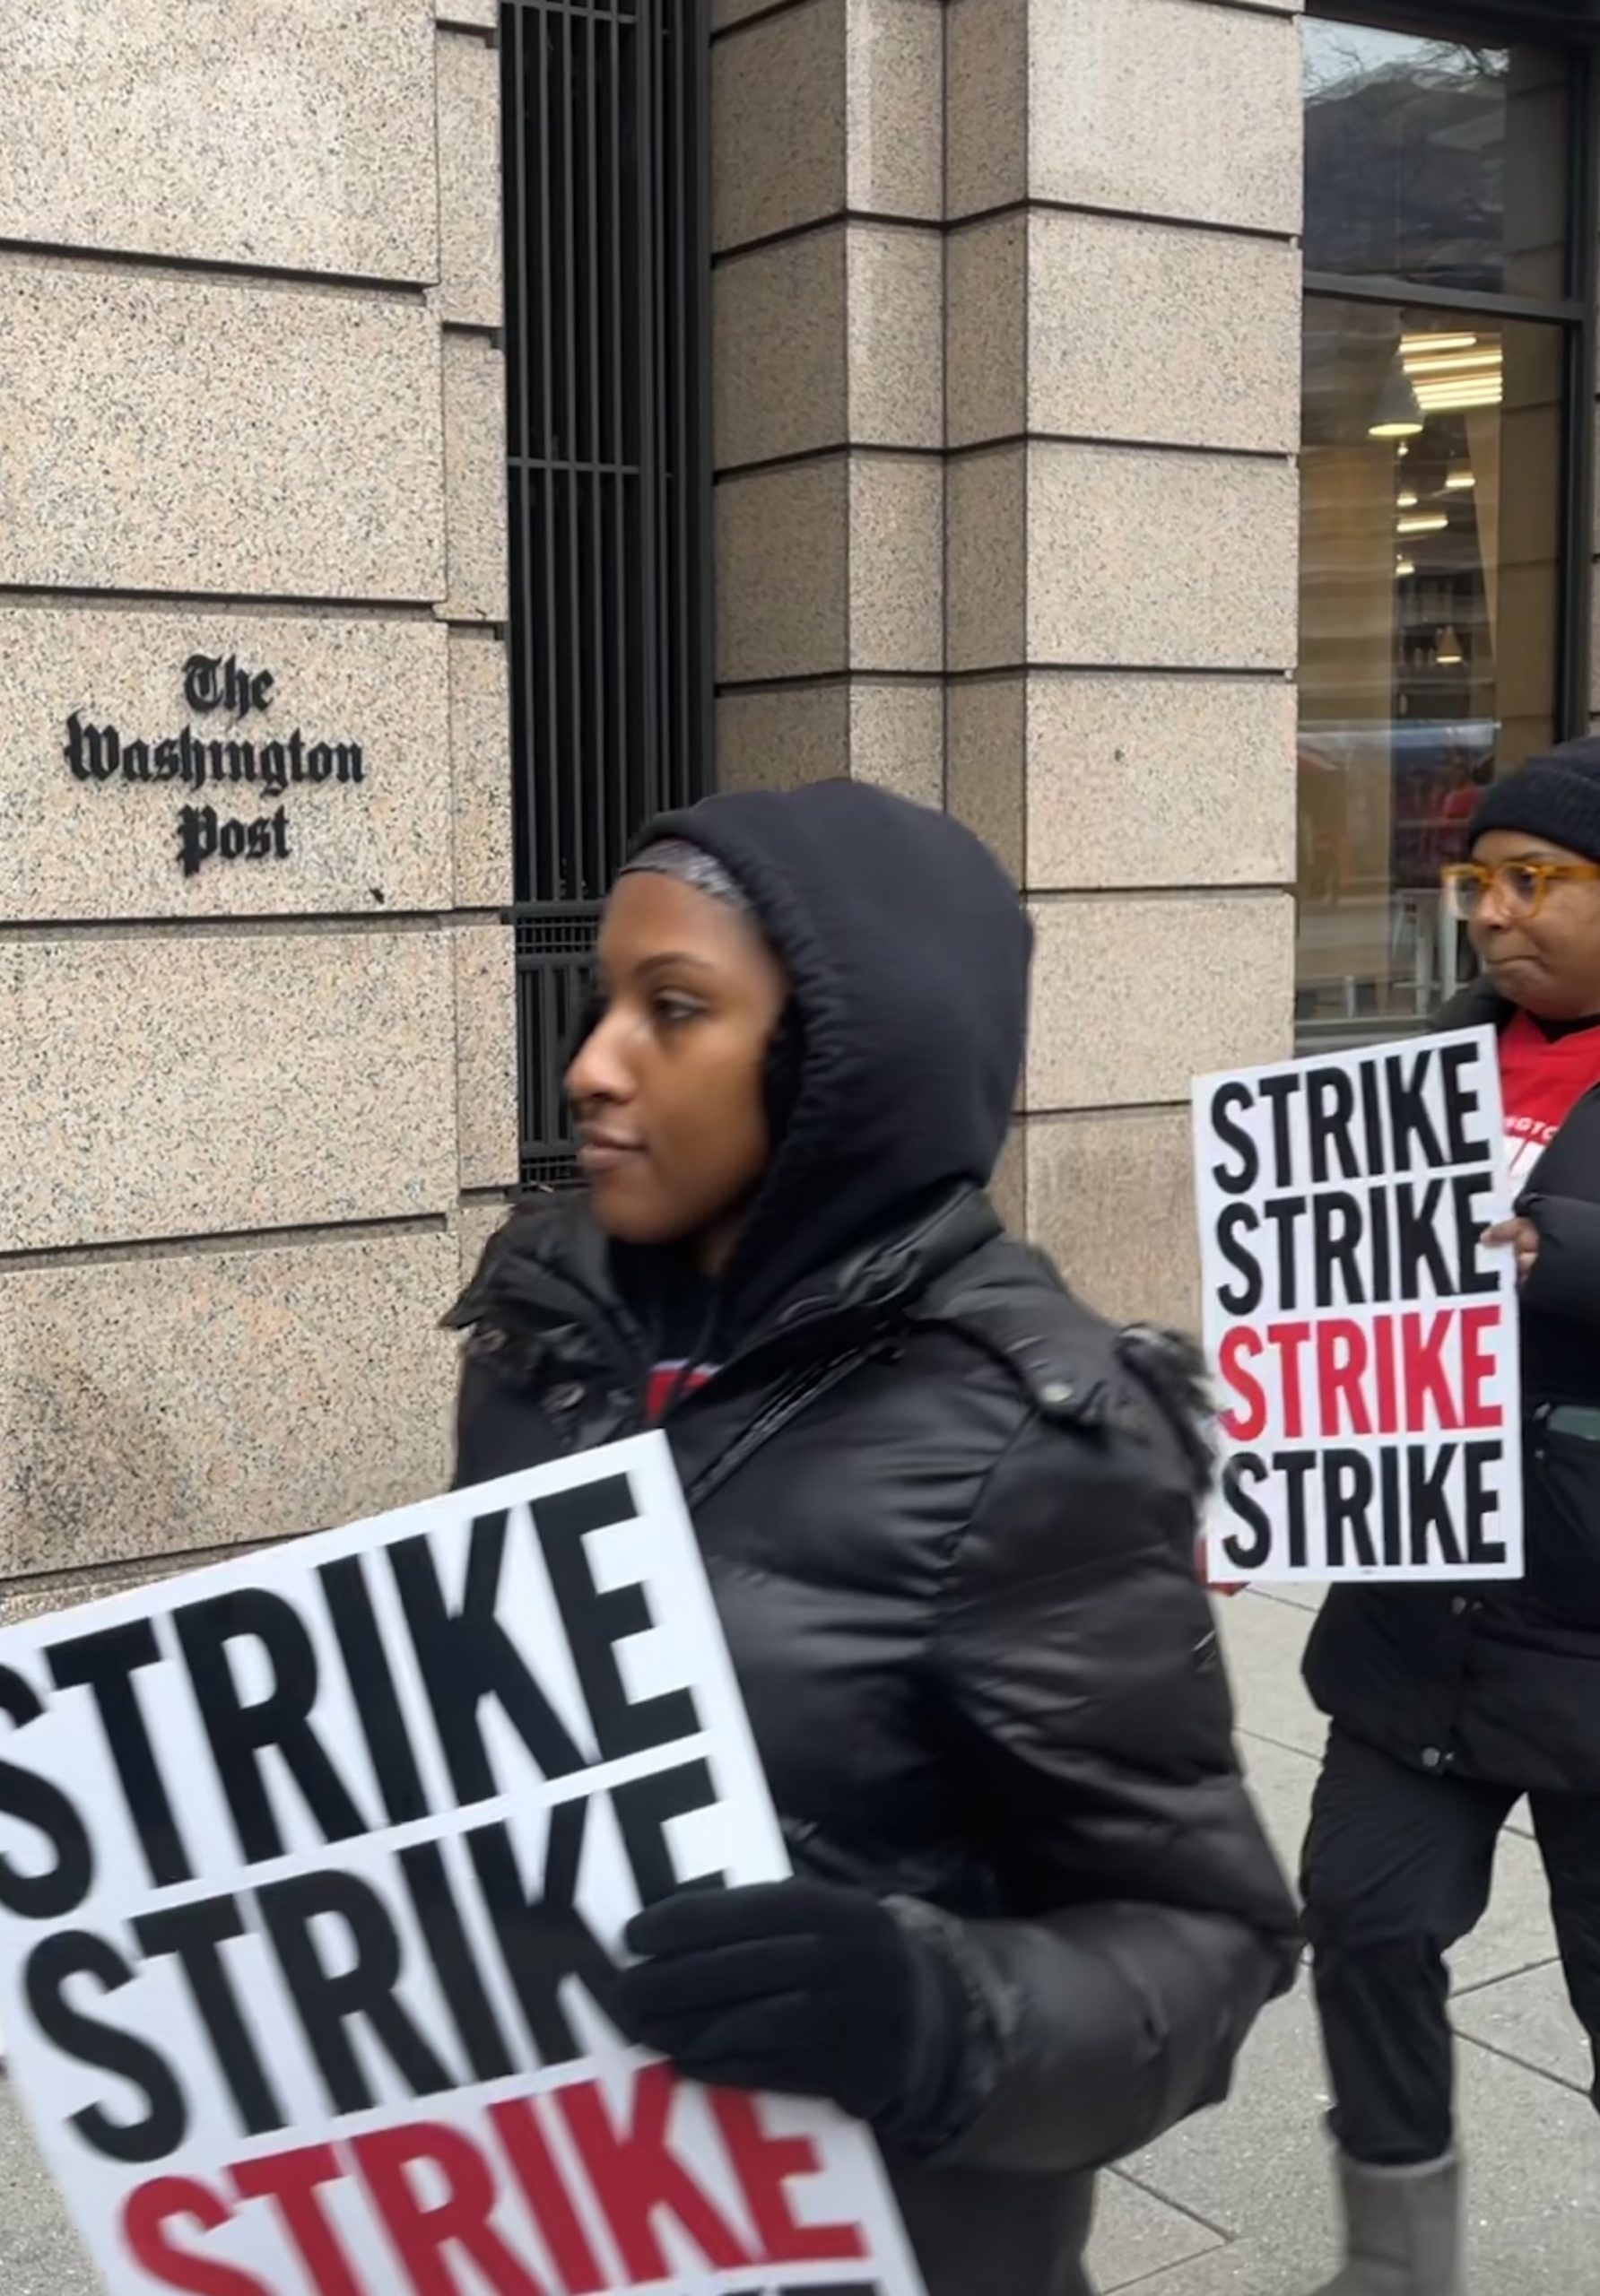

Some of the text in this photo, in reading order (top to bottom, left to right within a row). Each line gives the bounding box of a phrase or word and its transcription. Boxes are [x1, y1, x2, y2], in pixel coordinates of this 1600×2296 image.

[64, 708, 364, 796] Washington
[183, 654, 274, 718] The
[177, 804, 291, 877] Post
[1210, 1041, 1491, 1195] STRIKE
[1216, 1171, 1501, 1316] STRIKE
[1218, 1305, 1503, 1441] STRIKE
[1222, 1439, 1507, 1569] STRIKE
[0, 1472, 707, 1920] STRIKE
